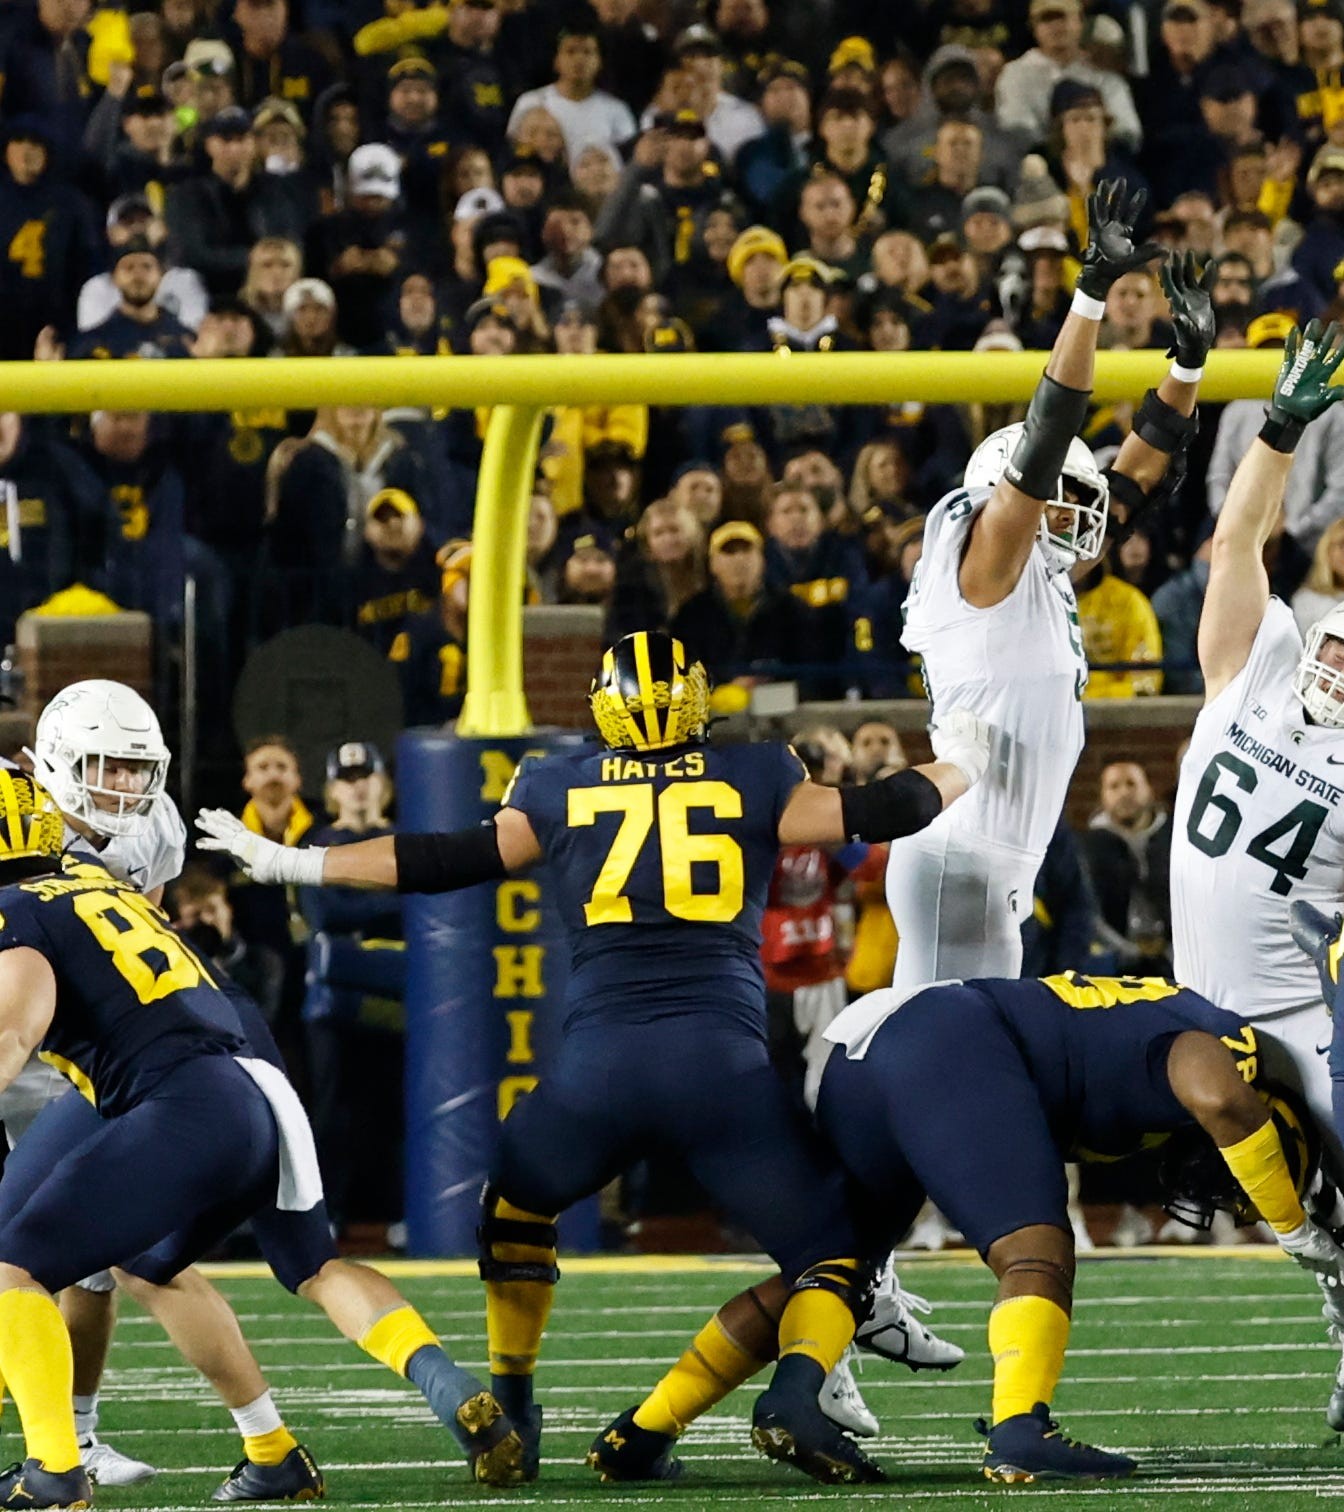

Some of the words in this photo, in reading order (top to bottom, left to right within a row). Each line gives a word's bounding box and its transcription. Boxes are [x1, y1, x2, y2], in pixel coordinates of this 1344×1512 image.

[9, 219, 46, 278] 4
[602, 752, 706, 782] HAYES
[1225, 721, 1297, 779] MICHIGAN
[1186, 750, 1330, 897] 64
[567, 781, 744, 927] 76
[604, 1430, 626, 1450] M
